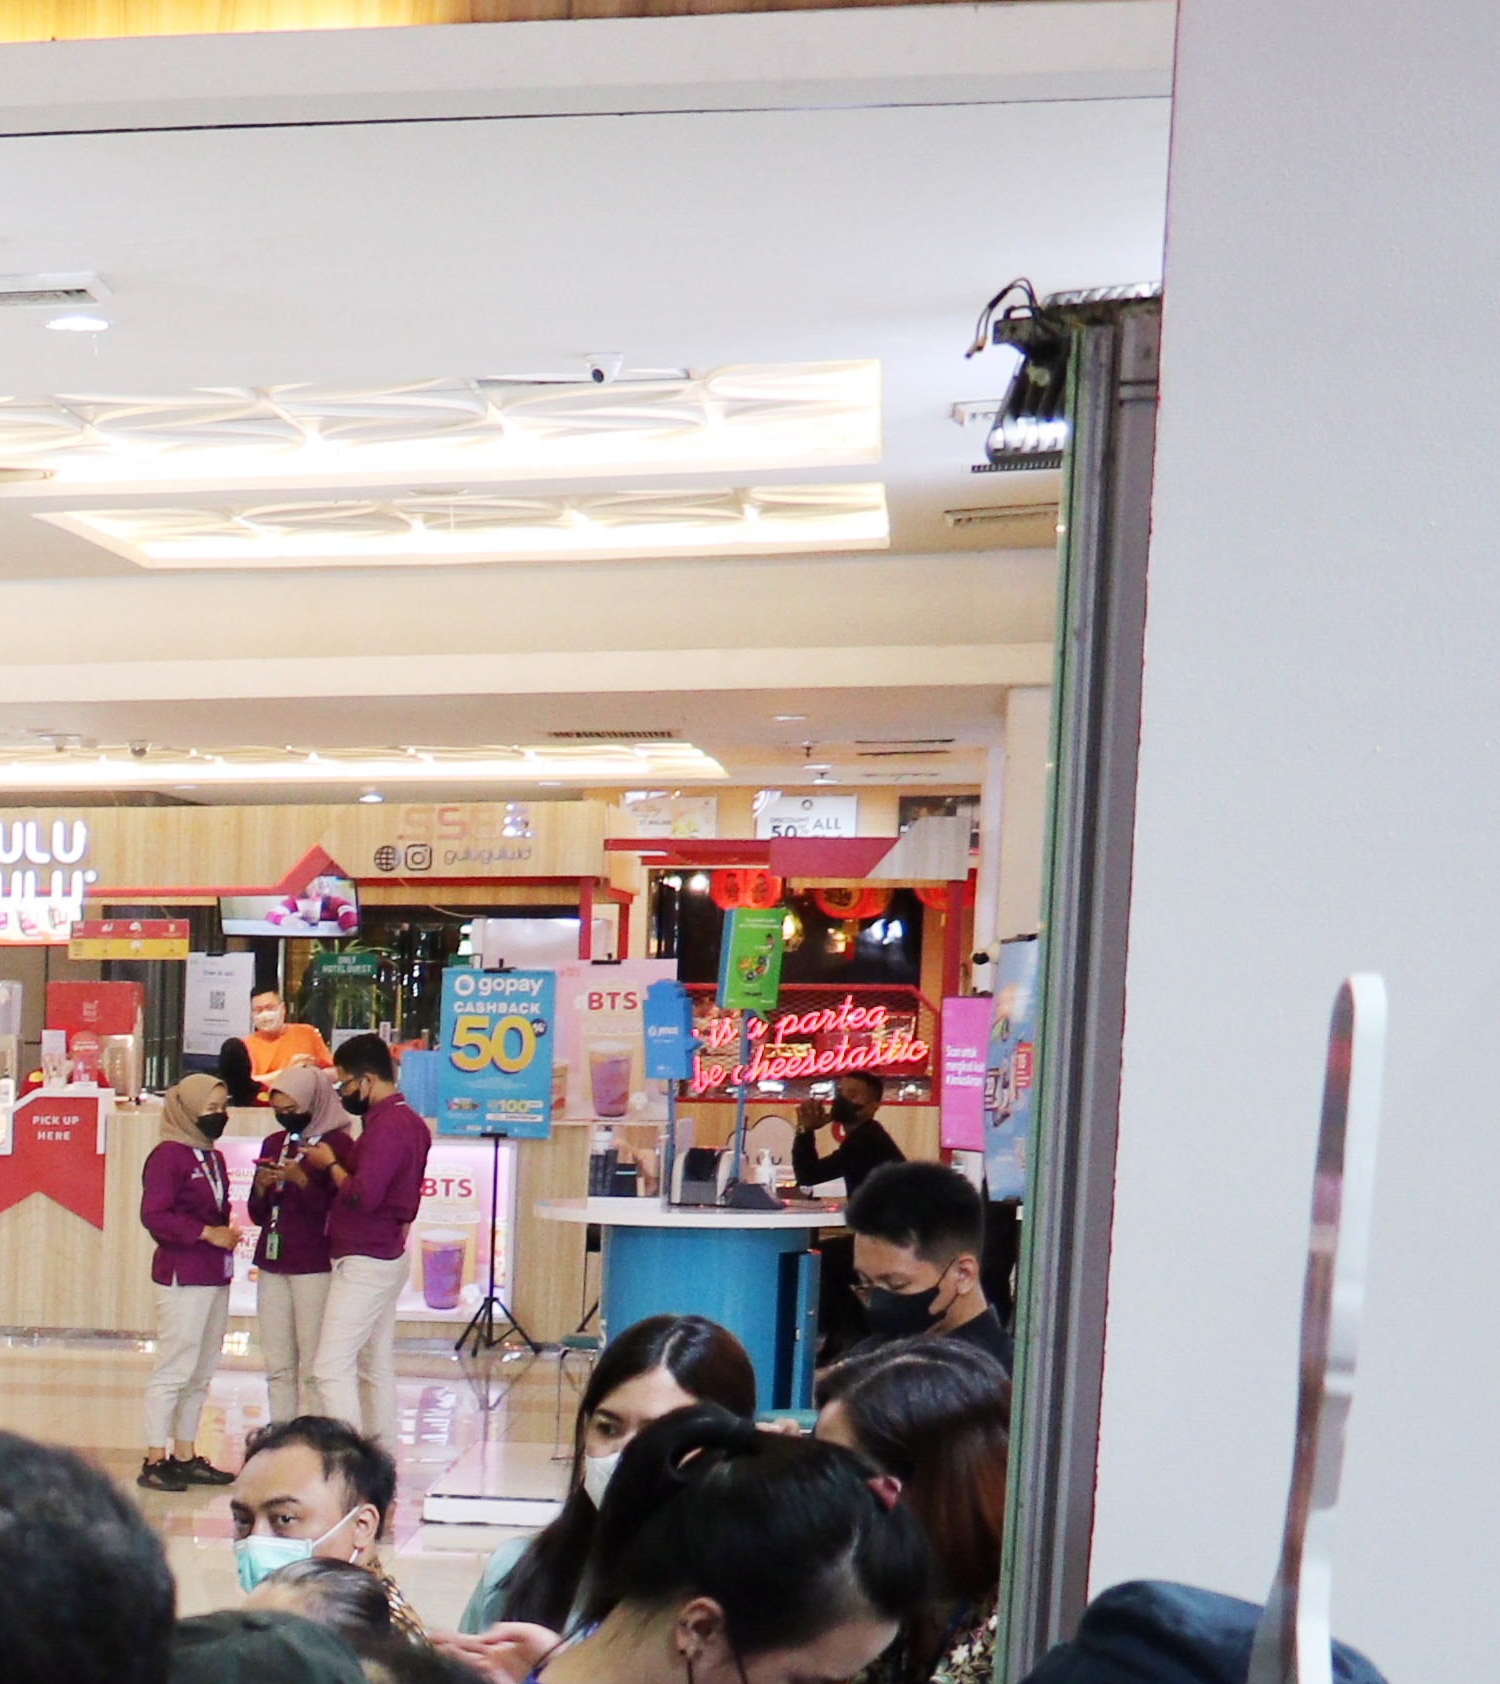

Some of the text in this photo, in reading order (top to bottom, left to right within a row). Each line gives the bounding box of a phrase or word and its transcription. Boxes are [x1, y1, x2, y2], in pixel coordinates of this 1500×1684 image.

[812, 817, 842, 830] ALL
[478, 976, 544, 995] gopay
[453, 1001, 540, 1014] CASHBACK
[588, 991, 638, 1011] BTS
[774, 995, 889, 1046] partea
[732, 1028, 930, 1087] cheesetastic
[32, 1116, 80, 1125] PICK UP
[37, 1131, 71, 1141] HERE
[420, 1178, 472, 1198] BTS
